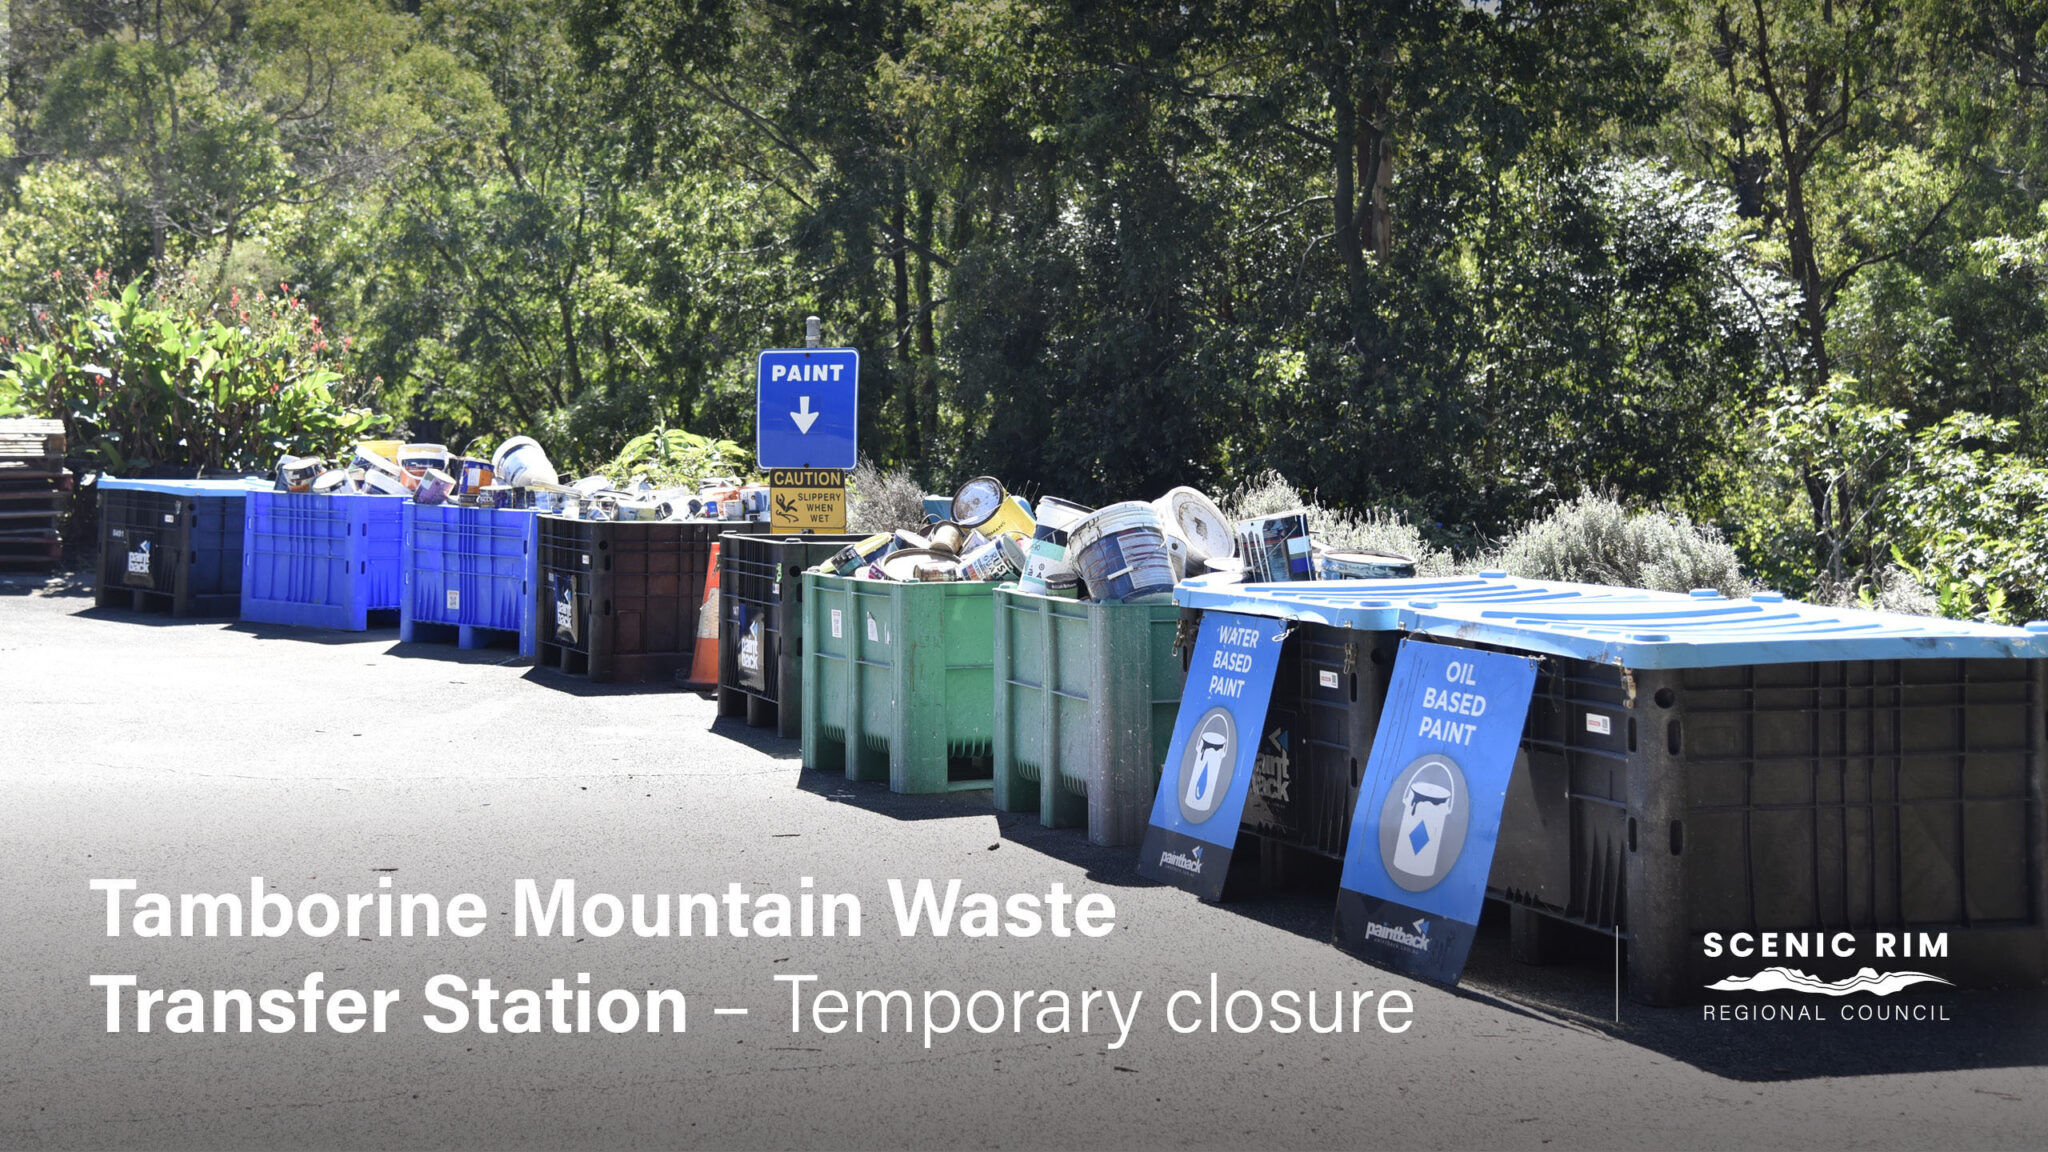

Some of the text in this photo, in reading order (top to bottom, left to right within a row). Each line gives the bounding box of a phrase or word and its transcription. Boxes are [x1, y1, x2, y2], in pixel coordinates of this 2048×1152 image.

[772, 364, 844, 382] PAINT
[774, 471, 841, 486] CAUTION
[798, 492, 841, 501] SLIPPERY
[806, 503, 833, 512] WHEN
[810, 514, 829, 523] WET
[129, 550, 150, 563] paint
[129, 562, 150, 574] back
[1218, 624, 1260, 649] WATER
[1212, 650, 1252, 674] BASED
[1446, 661, 1476, 686] OIL
[1209, 675, 1245, 698] PAINT
[1423, 687, 1487, 717] BASED
[1418, 716, 1477, 746] PAINT
[1255, 748, 1290, 779] aint
[1159, 851, 1204, 874] paintback
[1365, 921, 1430, 951] paintback
